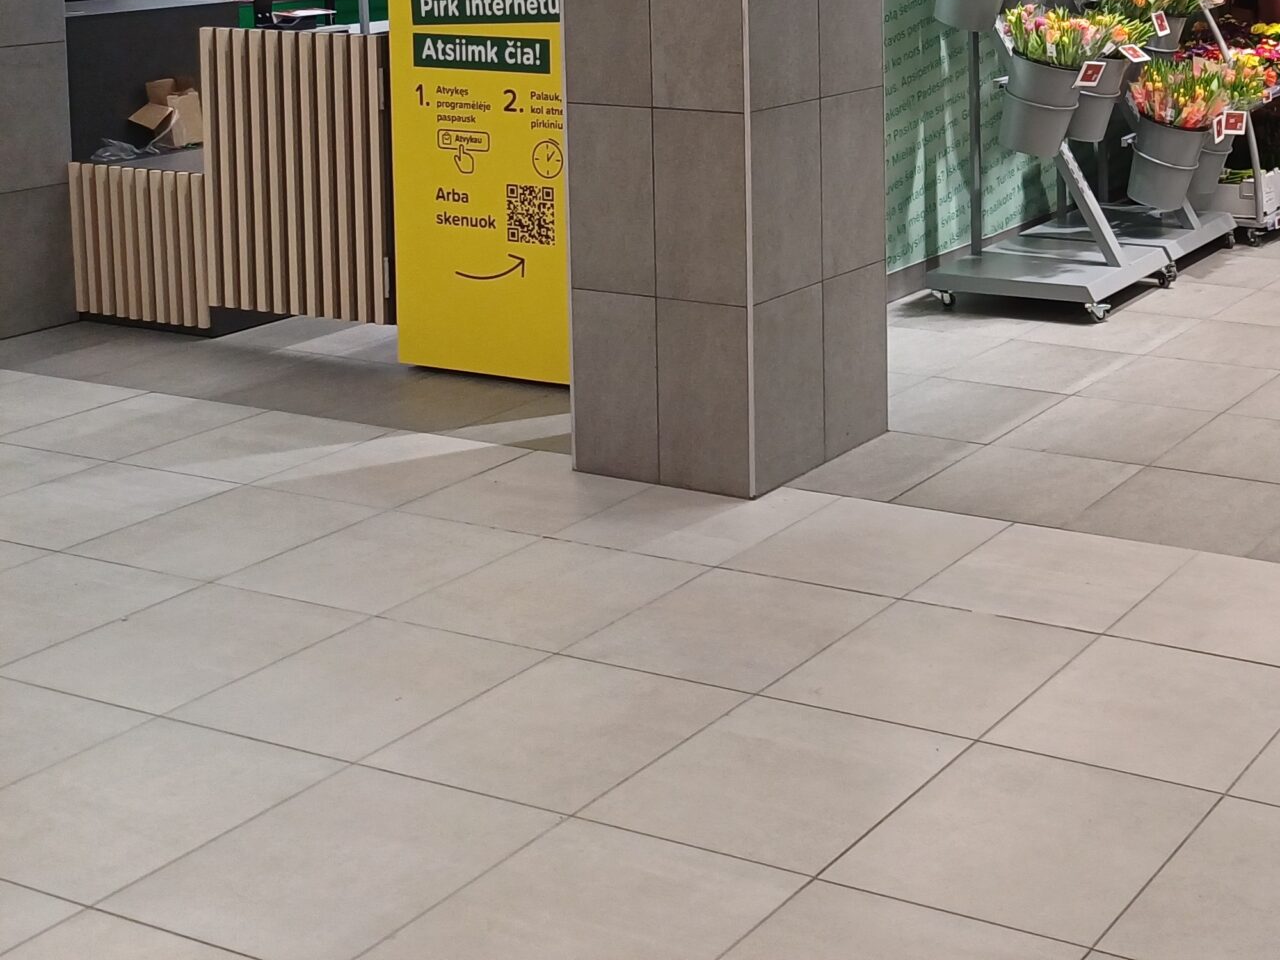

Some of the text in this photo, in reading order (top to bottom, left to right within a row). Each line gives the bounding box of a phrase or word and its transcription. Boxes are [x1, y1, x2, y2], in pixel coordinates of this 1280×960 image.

[421, 38, 541, 66] Atsiimk čia!
[415, 83, 431, 107] 1.
[436, 85, 469, 97] Atvykęs
[530, 91, 562, 102] Palauk,
[437, 100, 491, 112] programėlėje
[503, 89, 525, 113] 2.
[530, 106, 543, 115] kol
[437, 113, 476, 123] paspausk
[455, 134, 482, 145] Atvykau
[436, 187, 469, 204] Arba
[436, 212, 497, 230] skenuok
